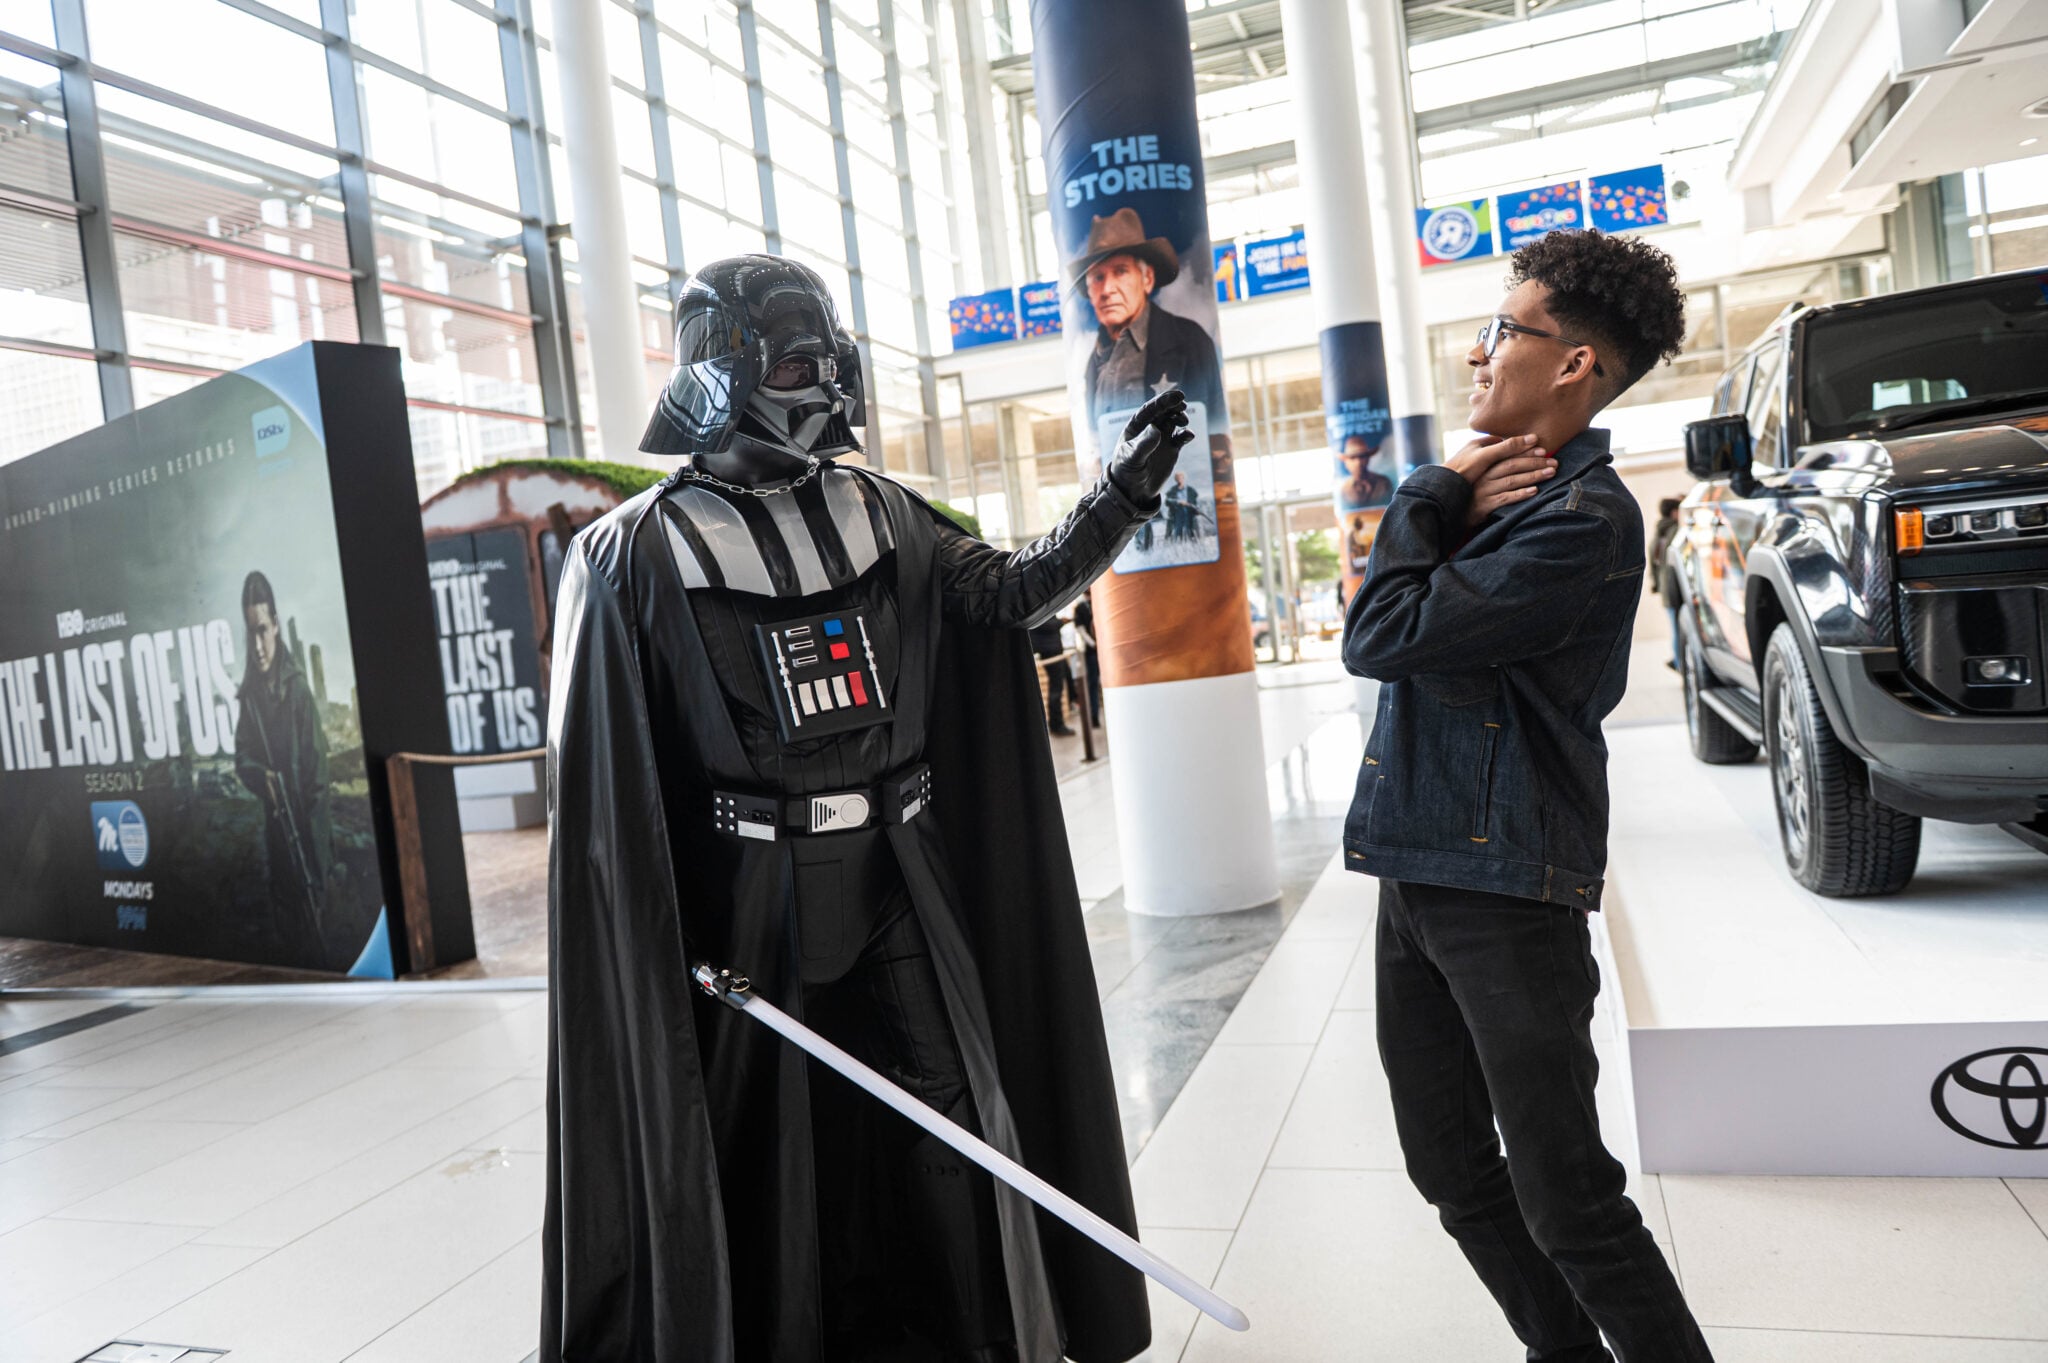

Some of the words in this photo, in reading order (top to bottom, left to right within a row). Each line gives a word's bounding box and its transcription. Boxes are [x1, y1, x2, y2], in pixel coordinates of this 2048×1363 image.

[1091, 135, 1159, 168] THE
[1065, 163, 1193, 208] STORIES
[1340, 397, 1369, 412] THE
[108, 466, 157, 496] SERIES
[167, 439, 236, 476] RETURNS
[56, 609, 84, 638] HBO
[84, 611, 127, 634] ORIGINAL
[431, 573, 494, 636] THE
[439, 629, 515, 694] LAST
[0, 656, 52, 770] THE
[44, 640, 134, 767] LAST
[130, 630, 181, 760] OF
[178, 619, 241, 756] US
[446, 692, 487, 754] OF
[492, 687, 540, 750] US
[85, 772, 133, 793] SEASON
[134, 770, 144, 791] 2
[104, 880, 154, 900] MONDAYS
